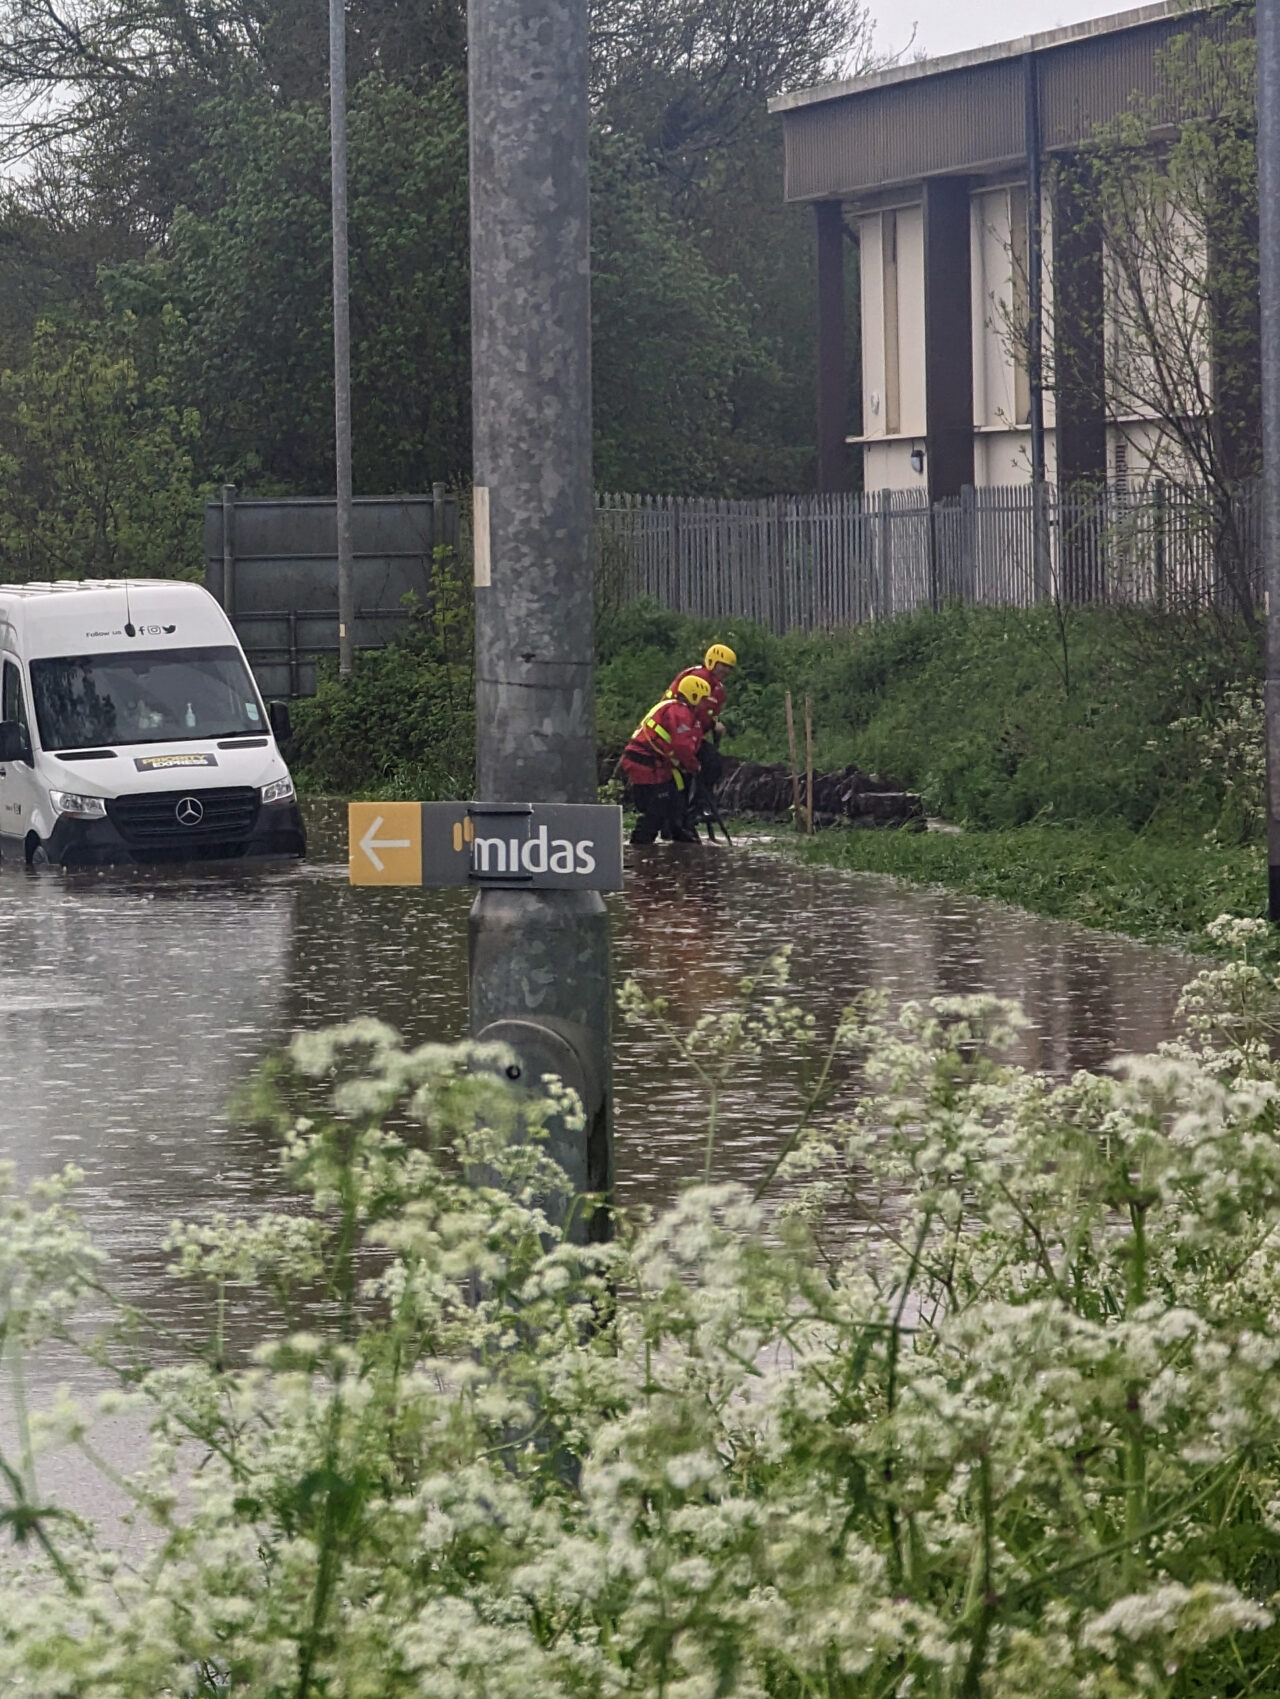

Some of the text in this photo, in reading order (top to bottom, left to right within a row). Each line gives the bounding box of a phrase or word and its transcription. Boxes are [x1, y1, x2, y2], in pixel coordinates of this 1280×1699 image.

[86, 629, 110, 637] Follow
[142, 754, 208, 765] PRIORITY
[152, 758, 209, 768] EXPRESS
[474, 824, 597, 875] midas
